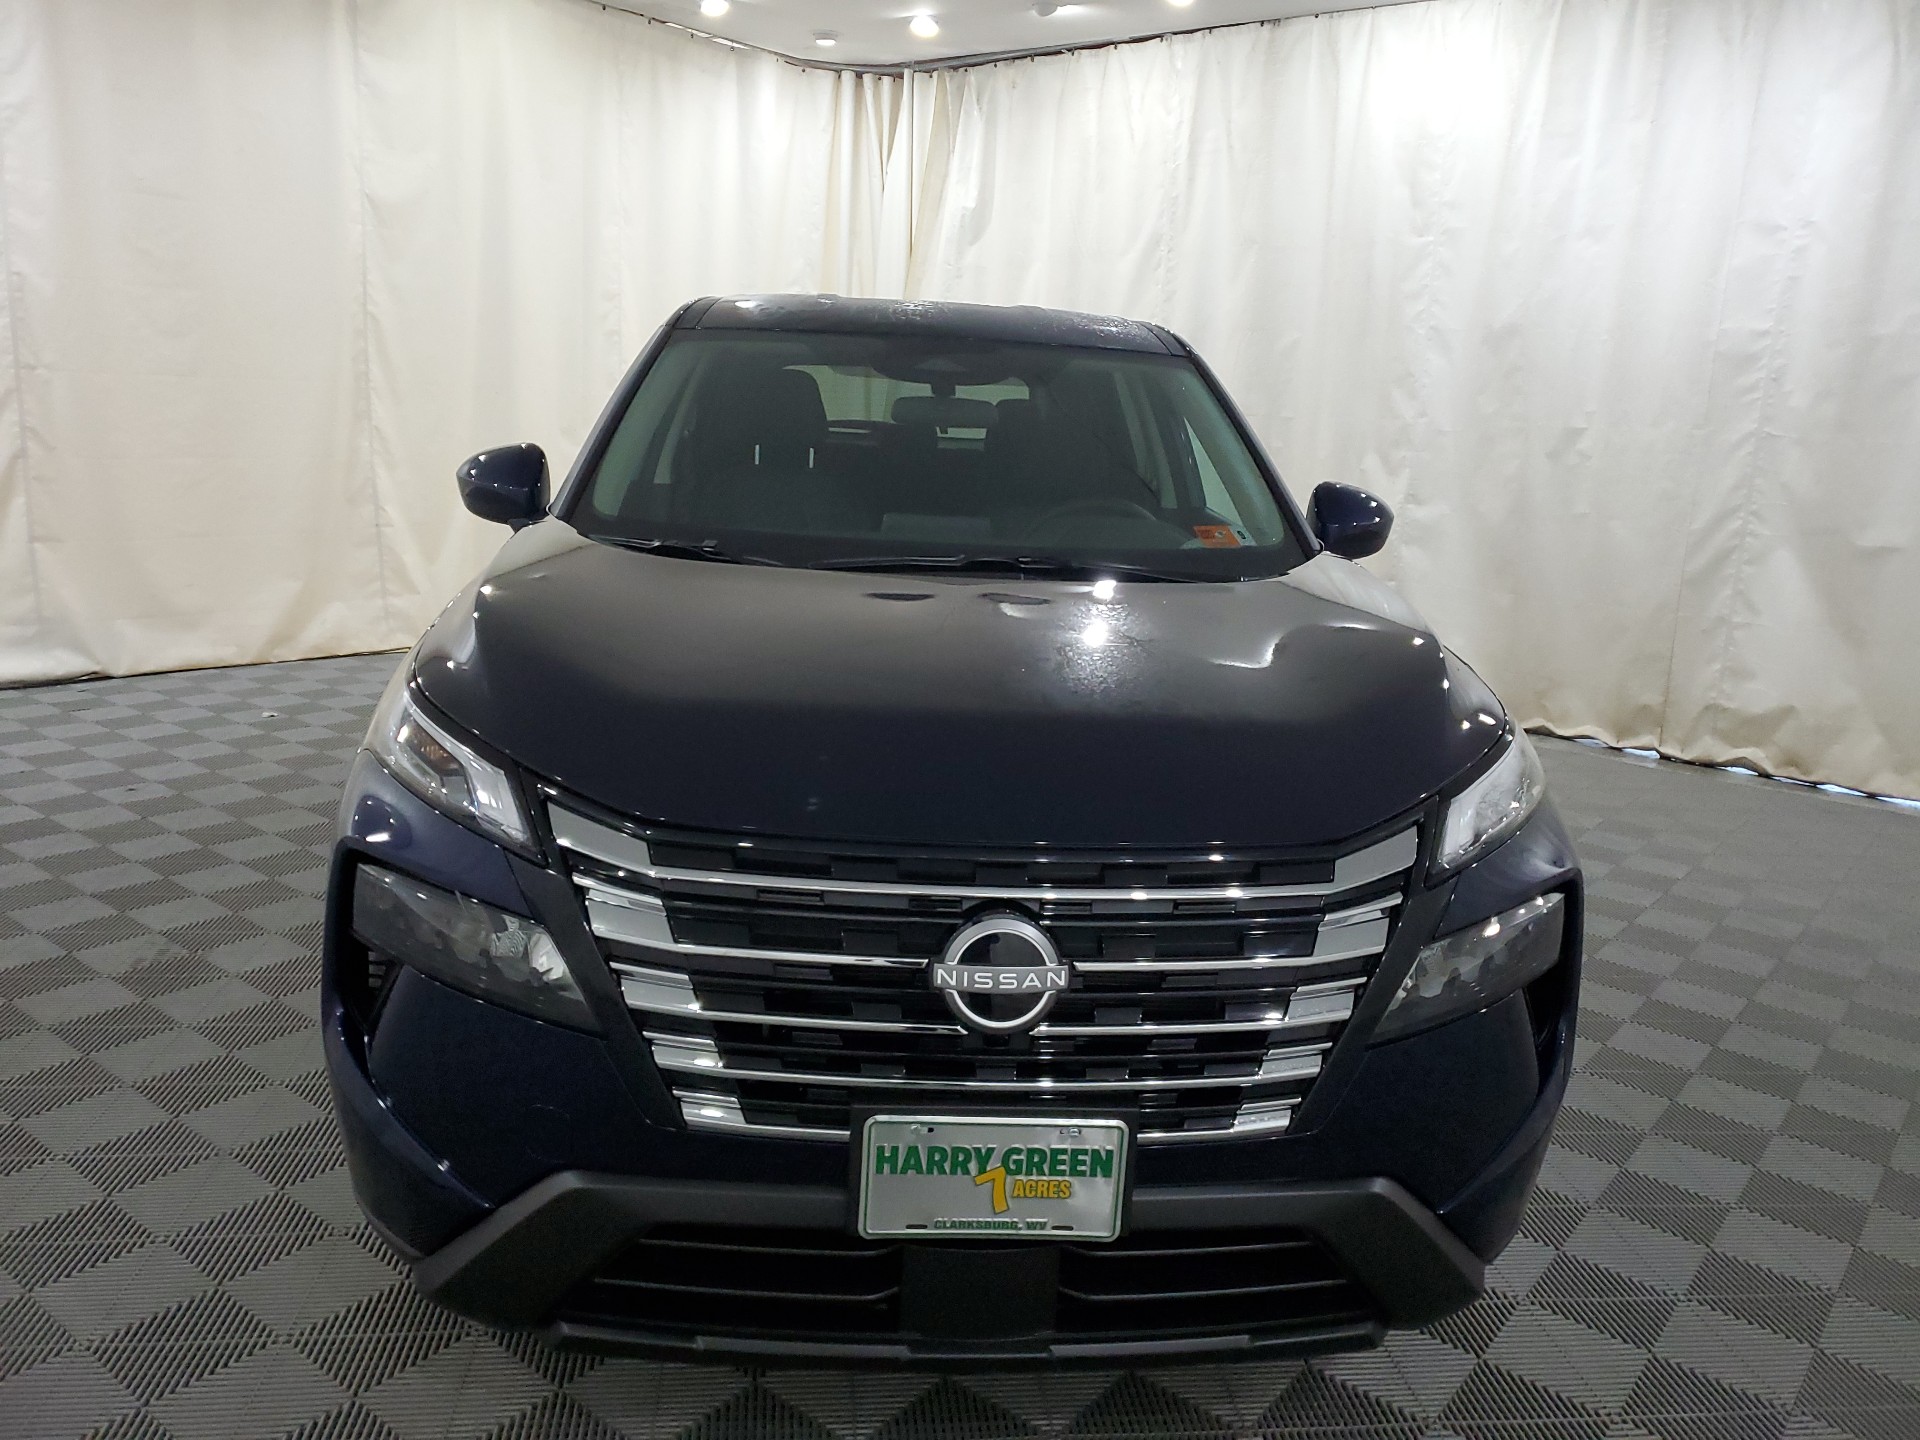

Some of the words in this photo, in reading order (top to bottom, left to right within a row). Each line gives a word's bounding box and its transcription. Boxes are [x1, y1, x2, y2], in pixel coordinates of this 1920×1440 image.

[937, 969, 1066, 989] NISSAN
[875, 1144, 995, 1175] HARRY
[1001, 1145, 1114, 1178] GREEN
[973, 1165, 1010, 1214] 7
[1012, 1179, 1071, 1199] ACRES
[1025, 1218, 1049, 1230] WV
